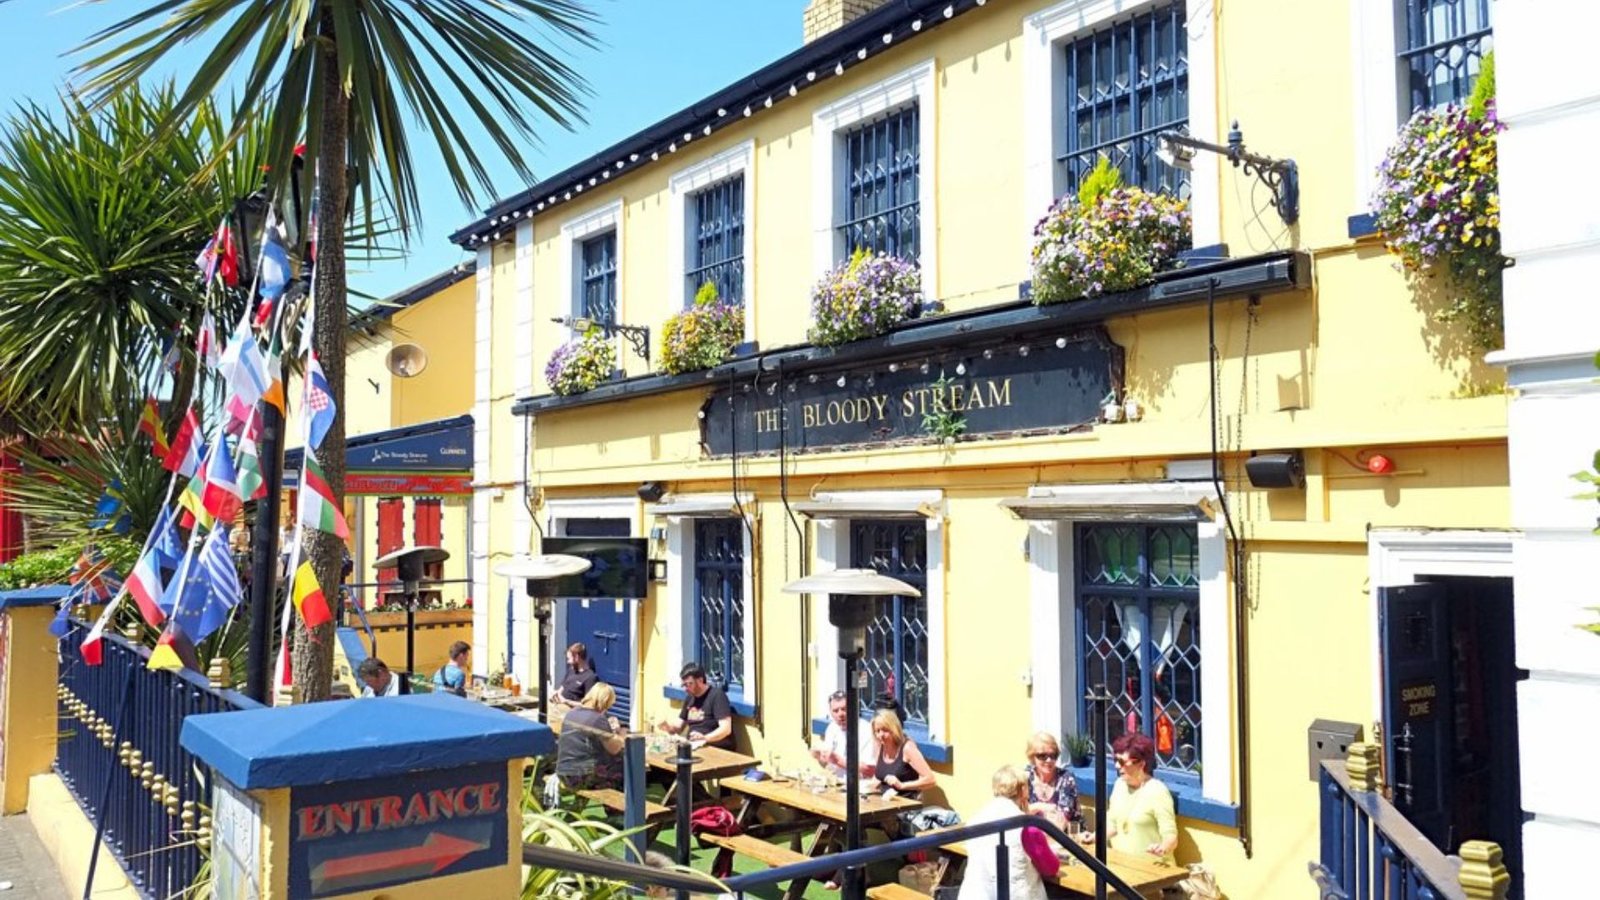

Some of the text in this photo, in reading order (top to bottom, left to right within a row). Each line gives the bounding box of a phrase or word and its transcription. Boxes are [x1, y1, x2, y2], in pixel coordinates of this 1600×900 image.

[754, 378, 1012, 433] THE BLOODY STREAM
[1402, 685, 1436, 702] SMOKING
[1409, 701, 1430, 716] ZONE
[297, 782, 501, 841] ENTRANCE
